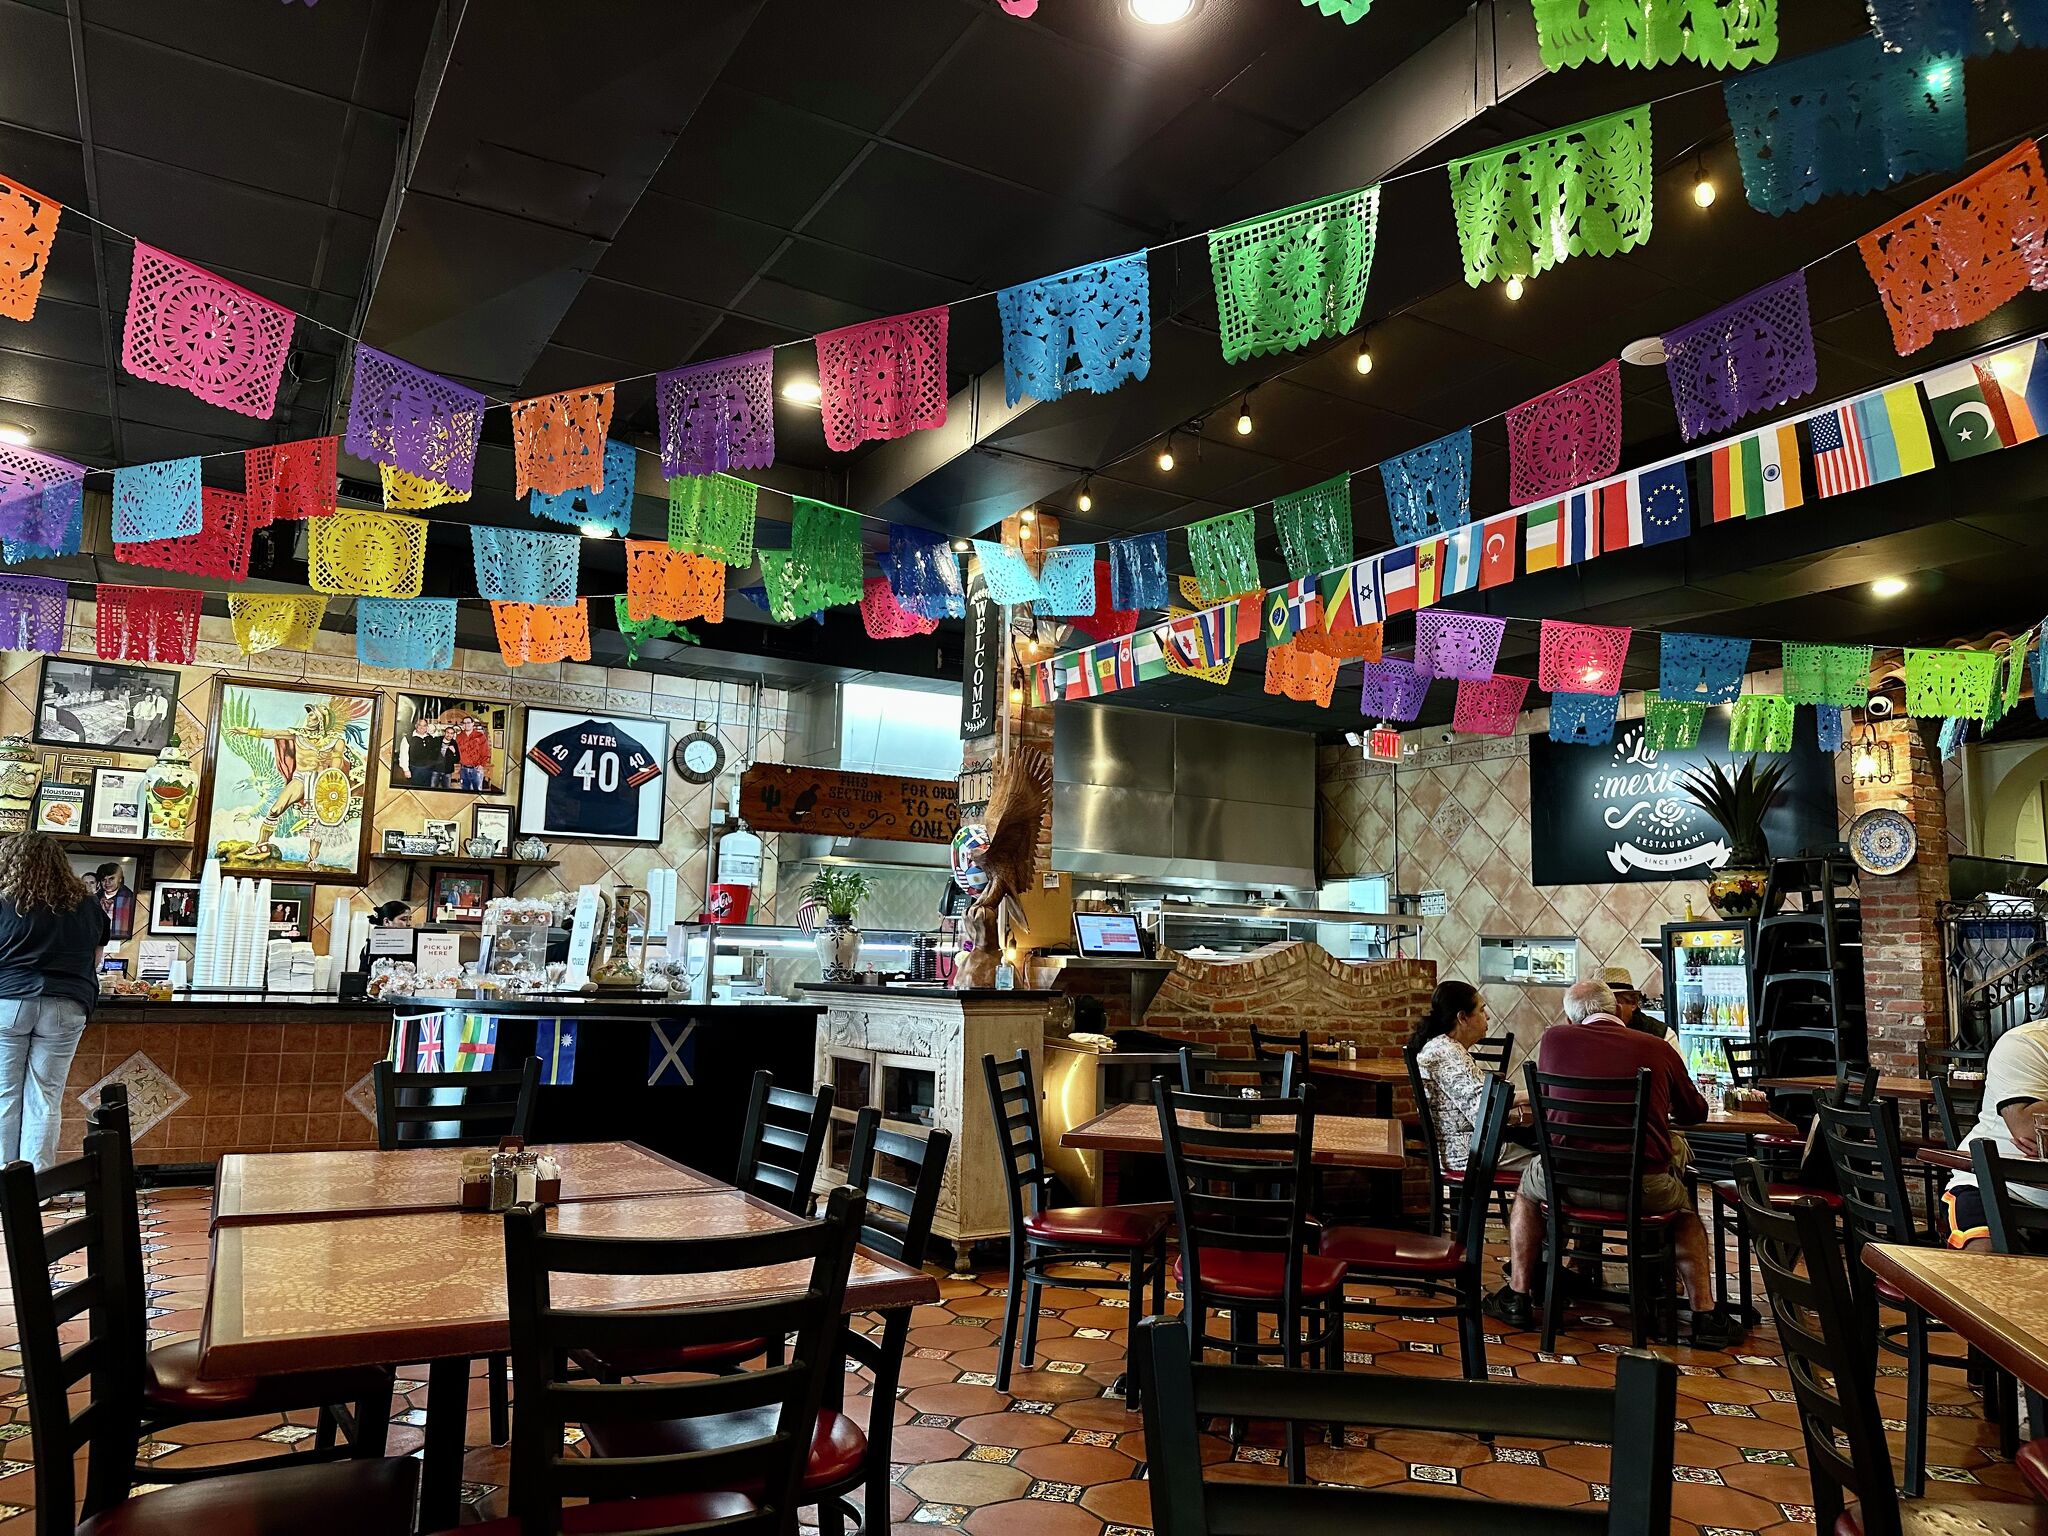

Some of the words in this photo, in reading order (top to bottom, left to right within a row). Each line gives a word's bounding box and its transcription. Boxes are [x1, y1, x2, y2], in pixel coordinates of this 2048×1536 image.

[972, 599, 988, 720] WELCOME
[580, 733, 617, 748] SAYERS
[1374, 732, 1401, 759] EXIT
[551, 744, 569, 761] 40
[629, 752, 645, 769] 40
[573, 749, 620, 793] 40
[839, 774, 869, 788] THIS
[961, 776, 992, 803] 1018
[43, 787, 81, 797] Houstonia
[901, 783, 929, 798] FOR
[931, 786, 958, 800] ORD
[909, 819, 960, 840] ONLY
[1635, 831, 1705, 849] RESTAURANT
[1644, 857, 1669, 865] SINCE
